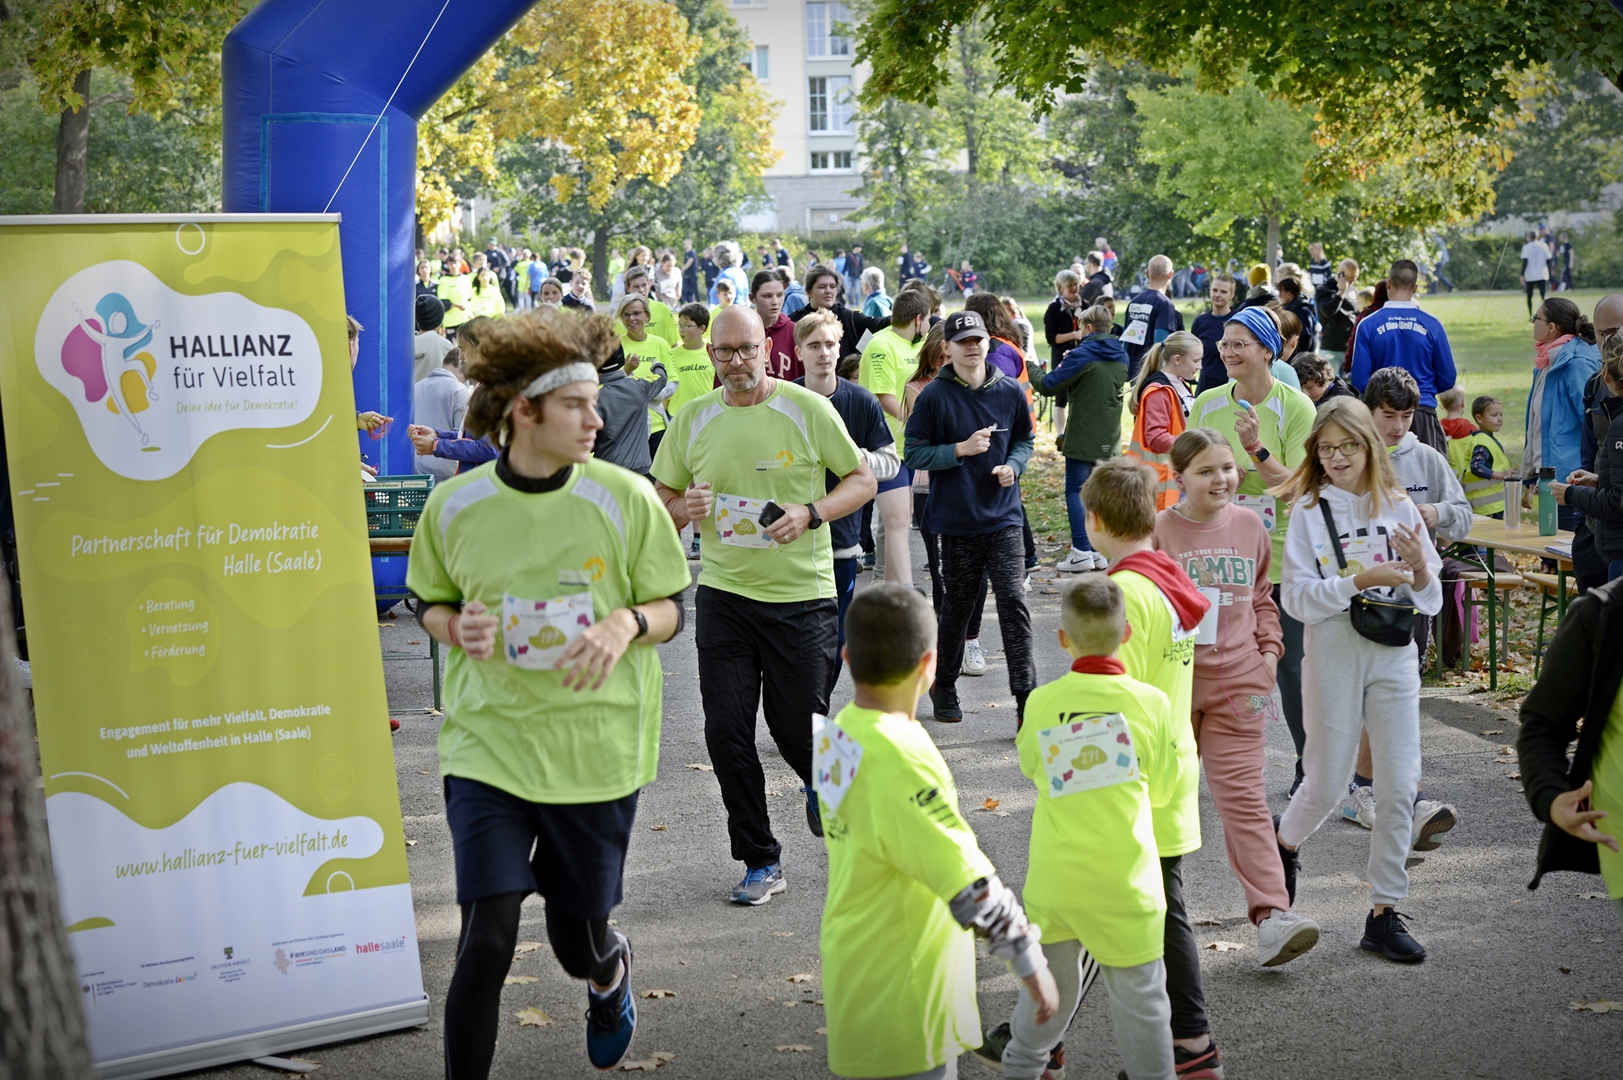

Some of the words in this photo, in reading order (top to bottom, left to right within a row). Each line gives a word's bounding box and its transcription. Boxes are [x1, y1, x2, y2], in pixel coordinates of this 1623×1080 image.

[955, 316, 980, 330] FBI
[170, 334, 292, 358] HALLIANZ
[173, 366, 205, 389] für
[212, 364, 296, 388] Vielfalt
[176, 401, 202, 414] Deine
[204, 400, 223, 412] Idee
[224, 400, 240, 413] für
[243, 398, 298, 412] Demokratie!
[71, 526, 192, 557] Partnerschaft
[196, 525, 224, 550] für
[228, 520, 319, 545] Demokratie
[739, 522, 752, 532] 200
[223, 552, 262, 576] Halle
[266, 549, 322, 574] (Saale)
[146, 598, 194, 614] Beratung
[148, 620, 209, 636] Vernetzung
[151, 643, 206, 660] Förderung
[100, 720, 170, 740] Engagement
[172, 718, 190, 732] für
[192, 714, 222, 728] mehr
[224, 709, 267, 726] Vielfalt,
[269, 704, 331, 720] Demokratie
[126, 745, 148, 758] und
[150, 735, 228, 756] Weltoffenheit
[230, 732, 242, 746] in
[242, 730, 272, 744] Halle
[275, 726, 311, 743] (Saale)
[116, 829, 349, 879] www.hallianz-fuer-vielfalt.de
